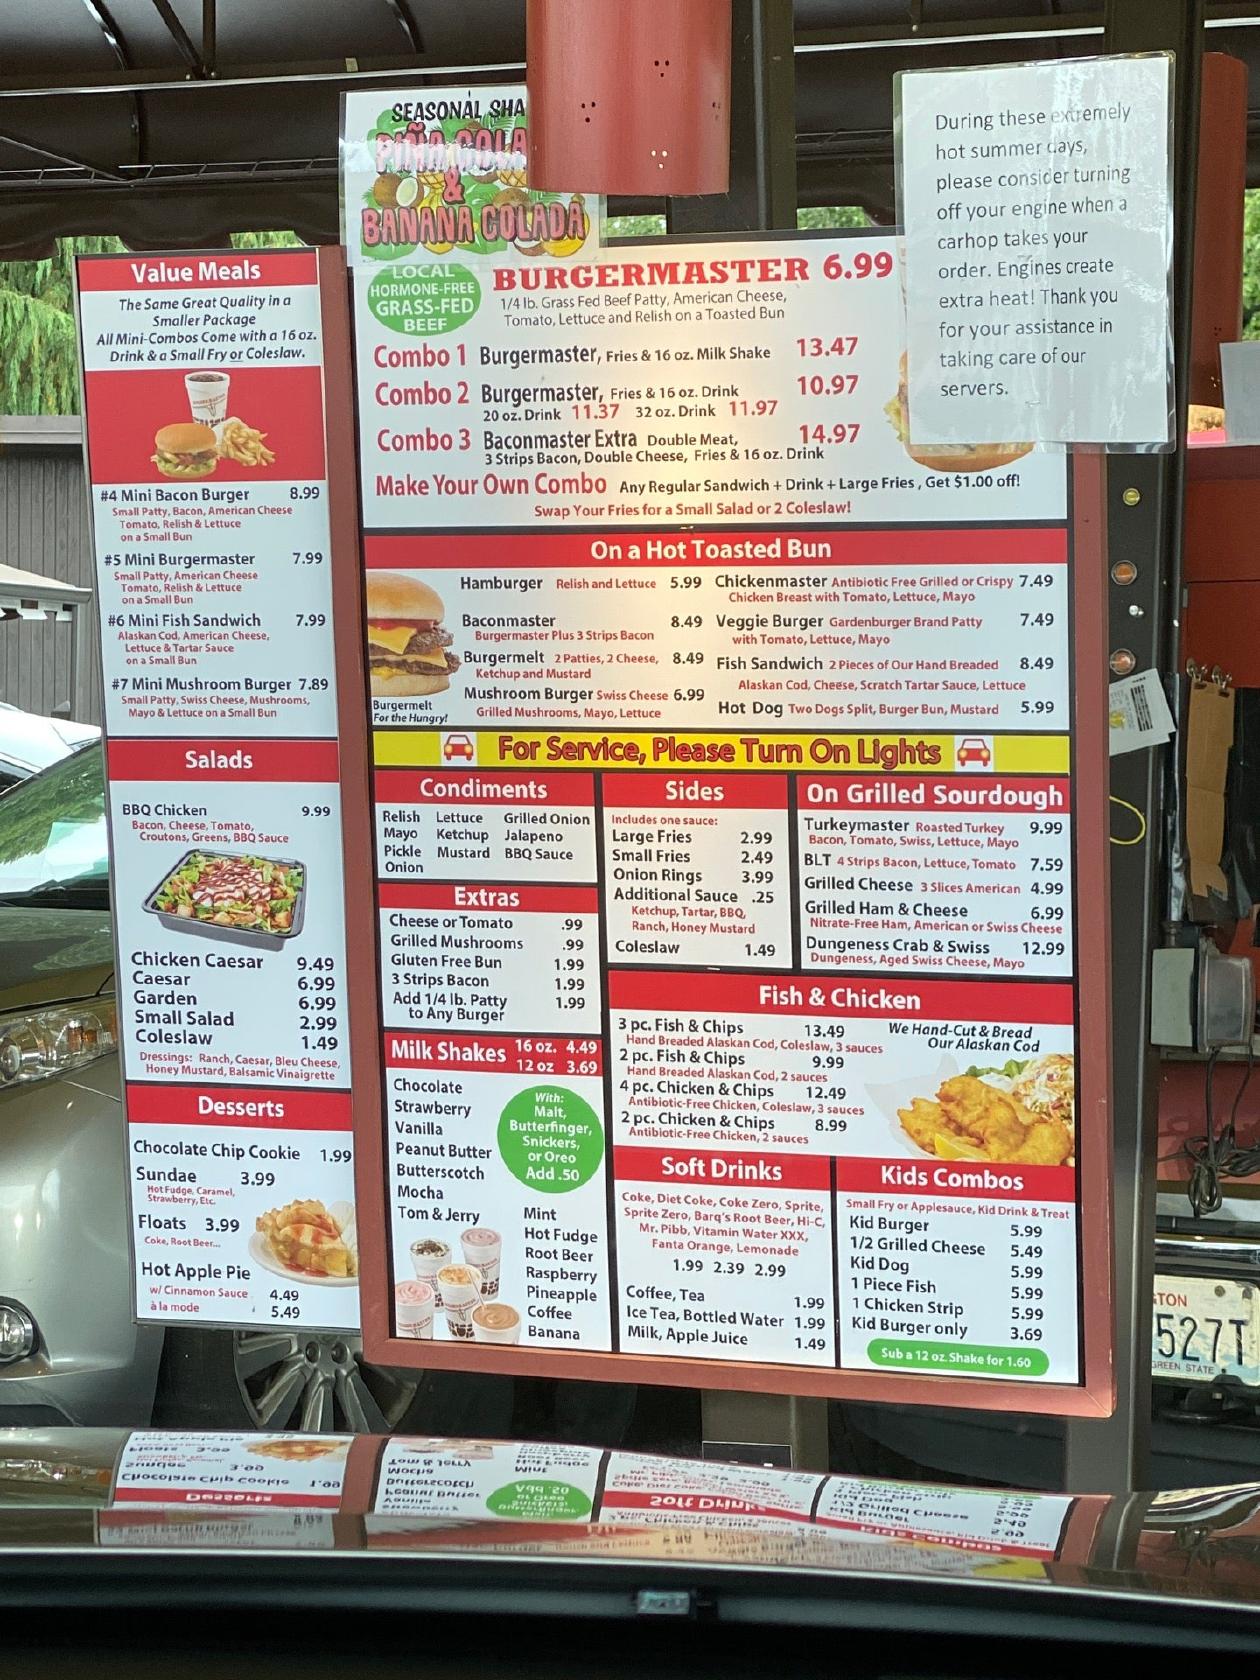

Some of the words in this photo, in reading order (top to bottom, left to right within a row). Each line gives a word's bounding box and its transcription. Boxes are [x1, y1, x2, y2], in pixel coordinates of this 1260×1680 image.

[391, 99, 482, 122] SEASONAL
[488, 99, 526, 118] SHA
[935, 113, 994, 132] During
[998, 109, 1047, 127] these
[1051, 102, 1131, 124] extremely
[454, 127, 527, 172] COLA
[936, 144, 966, 161] hot
[970, 143, 1042, 160] summer
[442, 168, 465, 205] &
[361, 206, 475, 247] BANANA
[480, 201, 588, 244] COLADA
[131, 262, 193, 283] Value
[198, 259, 261, 280] Meals
[392, 264, 455, 280] LOCAL
[492, 256, 810, 291] BURGERMASTER
[823, 251, 892, 280] 6.99
[370, 281, 475, 297] HORMONE-FREE
[375, 297, 475, 316] GRASS-FED
[500, 297, 520, 310] 1/4
[523, 296, 538, 309] lb.
[541, 296, 575, 309] Grass
[577, 294, 600, 307] Fed
[604, 292, 632, 307] Beef
[634, 293, 669, 308] Patty,
[673, 291, 733, 304] American
[736, 289, 787, 303] Cheese,
[403, 317, 448, 333] BEEF
[374, 342, 450, 368] Combo
[457, 343, 465, 366] 1
[480, 345, 601, 369] Burgermaster,
[606, 349, 638, 362] Fries
[640, 349, 651, 361] &
[654, 349, 671, 361] 16
[674, 351, 694, 361] oz.
[696, 346, 726, 360] Milk
[729, 345, 771, 359] Shake
[796, 336, 858, 357] 13.47
[940, 382, 1008, 397] servers.
[376, 473, 429, 496] Make
[432, 474, 478, 495] Your
[483, 473, 529, 495] Own
[534, 471, 607, 494] Combo
[100, 490, 117, 502] #4
[121, 488, 151, 502] Mini
[155, 488, 198, 501] Bacon
[201, 487, 250, 503] Burger
[290, 486, 320, 500] 8.99
[112, 507, 139, 516] Small
[141, 507, 171, 518] Patty,
[172, 506, 206, 516] Bacon,
[208, 505, 256, 515] American
[257, 505, 293, 515] Cheese
[534, 505, 570, 520] Swap
[572, 504, 605, 516] Your
[607, 503, 640, 516] Fries
[641, 503, 662, 515] for
[665, 506, 673, 515] a
[675, 502, 712, 515] Small
[716, 501, 753, 515] Salad
[756, 505, 771, 514] or
[774, 502, 783, 514] 2
[786, 500, 851, 514] Coleslaw!
[590, 540, 624, 560] On
[627, 545, 641, 560] a
[646, 540, 687, 560] Hot
[691, 538, 781, 559] Toasted
[787, 538, 831, 558] Bun
[460, 575, 543, 593] Hamburger
[556, 578, 589, 589] Relish
[591, 578, 613, 589] and
[615, 578, 656, 589] Lettuce
[670, 576, 702, 589] 5.99
[715, 574, 828, 588] Chickenmaster
[831, 576, 888, 587] Antibiotic
[891, 576, 917, 587] Free
[919, 576, 958, 587] Grilled
[961, 578, 974, 586] or
[976, 576, 1014, 589] Crispy
[1019, 574, 1053, 587] 7.49
[373, 699, 432, 712] Burgermelt
[373, 713, 390, 724] For
[391, 713, 407, 724] the
[408, 713, 448, 725] Hungry!
[185, 750, 253, 768] Salads
[498, 735, 541, 760] For
[546, 735, 646, 765] Service,
[652, 736, 736, 765] Please
[740, 738, 804, 763] Turn
[809, 738, 851, 765] On
[857, 738, 942, 770] Lights
[420, 778, 547, 798] Condiments
[666, 780, 724, 800] Sides
[807, 783, 838, 802] On
[847, 782, 924, 804] Grilled
[933, 784, 1062, 810] Sourdough
[122, 803, 151, 816] BBQ
[154, 803, 207, 816] Chicken
[301, 805, 330, 817] 9.99
[611, 814, 657, 825] Includes
[660, 816, 681, 825] one
[682, 817, 718, 826] sauce:
[454, 886, 520, 908] Extras
[810, 917, 879, 929] Nitrate-Free
[881, 919, 911, 931] Ham,
[913, 919, 969, 931] American
[971, 923, 984, 932] or
[986, 921, 1018, 933] Swiss
[1020, 922, 1062, 934] Cheese
[759, 985, 803, 1005] Fish
[808, 987, 825, 1006] &
[831, 987, 920, 1009] Chicken
[392, 1039, 433, 1059] Milk
[437, 1041, 506, 1062] Shakes
[515, 1039, 532, 1052] 16
[535, 1042, 556, 1057] oz.
[566, 1040, 598, 1054] 4.49
[145, 1063, 179, 1076] Honey
[181, 1065, 227, 1077] Mustard,
[228, 1066, 275, 1078] Balsamic
[276, 1068, 335, 1082] Vinaigrette
[198, 1095, 284, 1117] Desserts
[509, 1119, 593, 1137] Butterfinger,
[133, 1139, 207, 1156] Chocolate
[211, 1143, 245, 1161] Chip
[248, 1144, 300, 1160] Cookie
[320, 1148, 352, 1163] 1.99
[661, 1156, 705, 1177] Soft
[711, 1158, 782, 1180] Drinks
[881, 1165, 928, 1186] Kids
[933, 1167, 1024, 1190] Combos
[158, 1300, 168, 1311] la
[170, 1302, 199, 1313] mode
[271, 1305, 300, 1319] 5.49
[1153, 1292, 1188, 1307] TON
[1155, 1313, 1249, 1366] 527T
[881, 1347, 903, 1361] Sub
[906, 1352, 913, 1362] a
[915, 1350, 929, 1362] 12
[931, 1354, 948, 1363] oz.
[948, 1350, 984, 1366] Shake
[986, 1352, 1004, 1367] for
[1006, 1356, 1032, 1369] 1.60
[1152, 1360, 1181, 1371] GREEN
[1185, 1364, 1215, 1374] STATE
